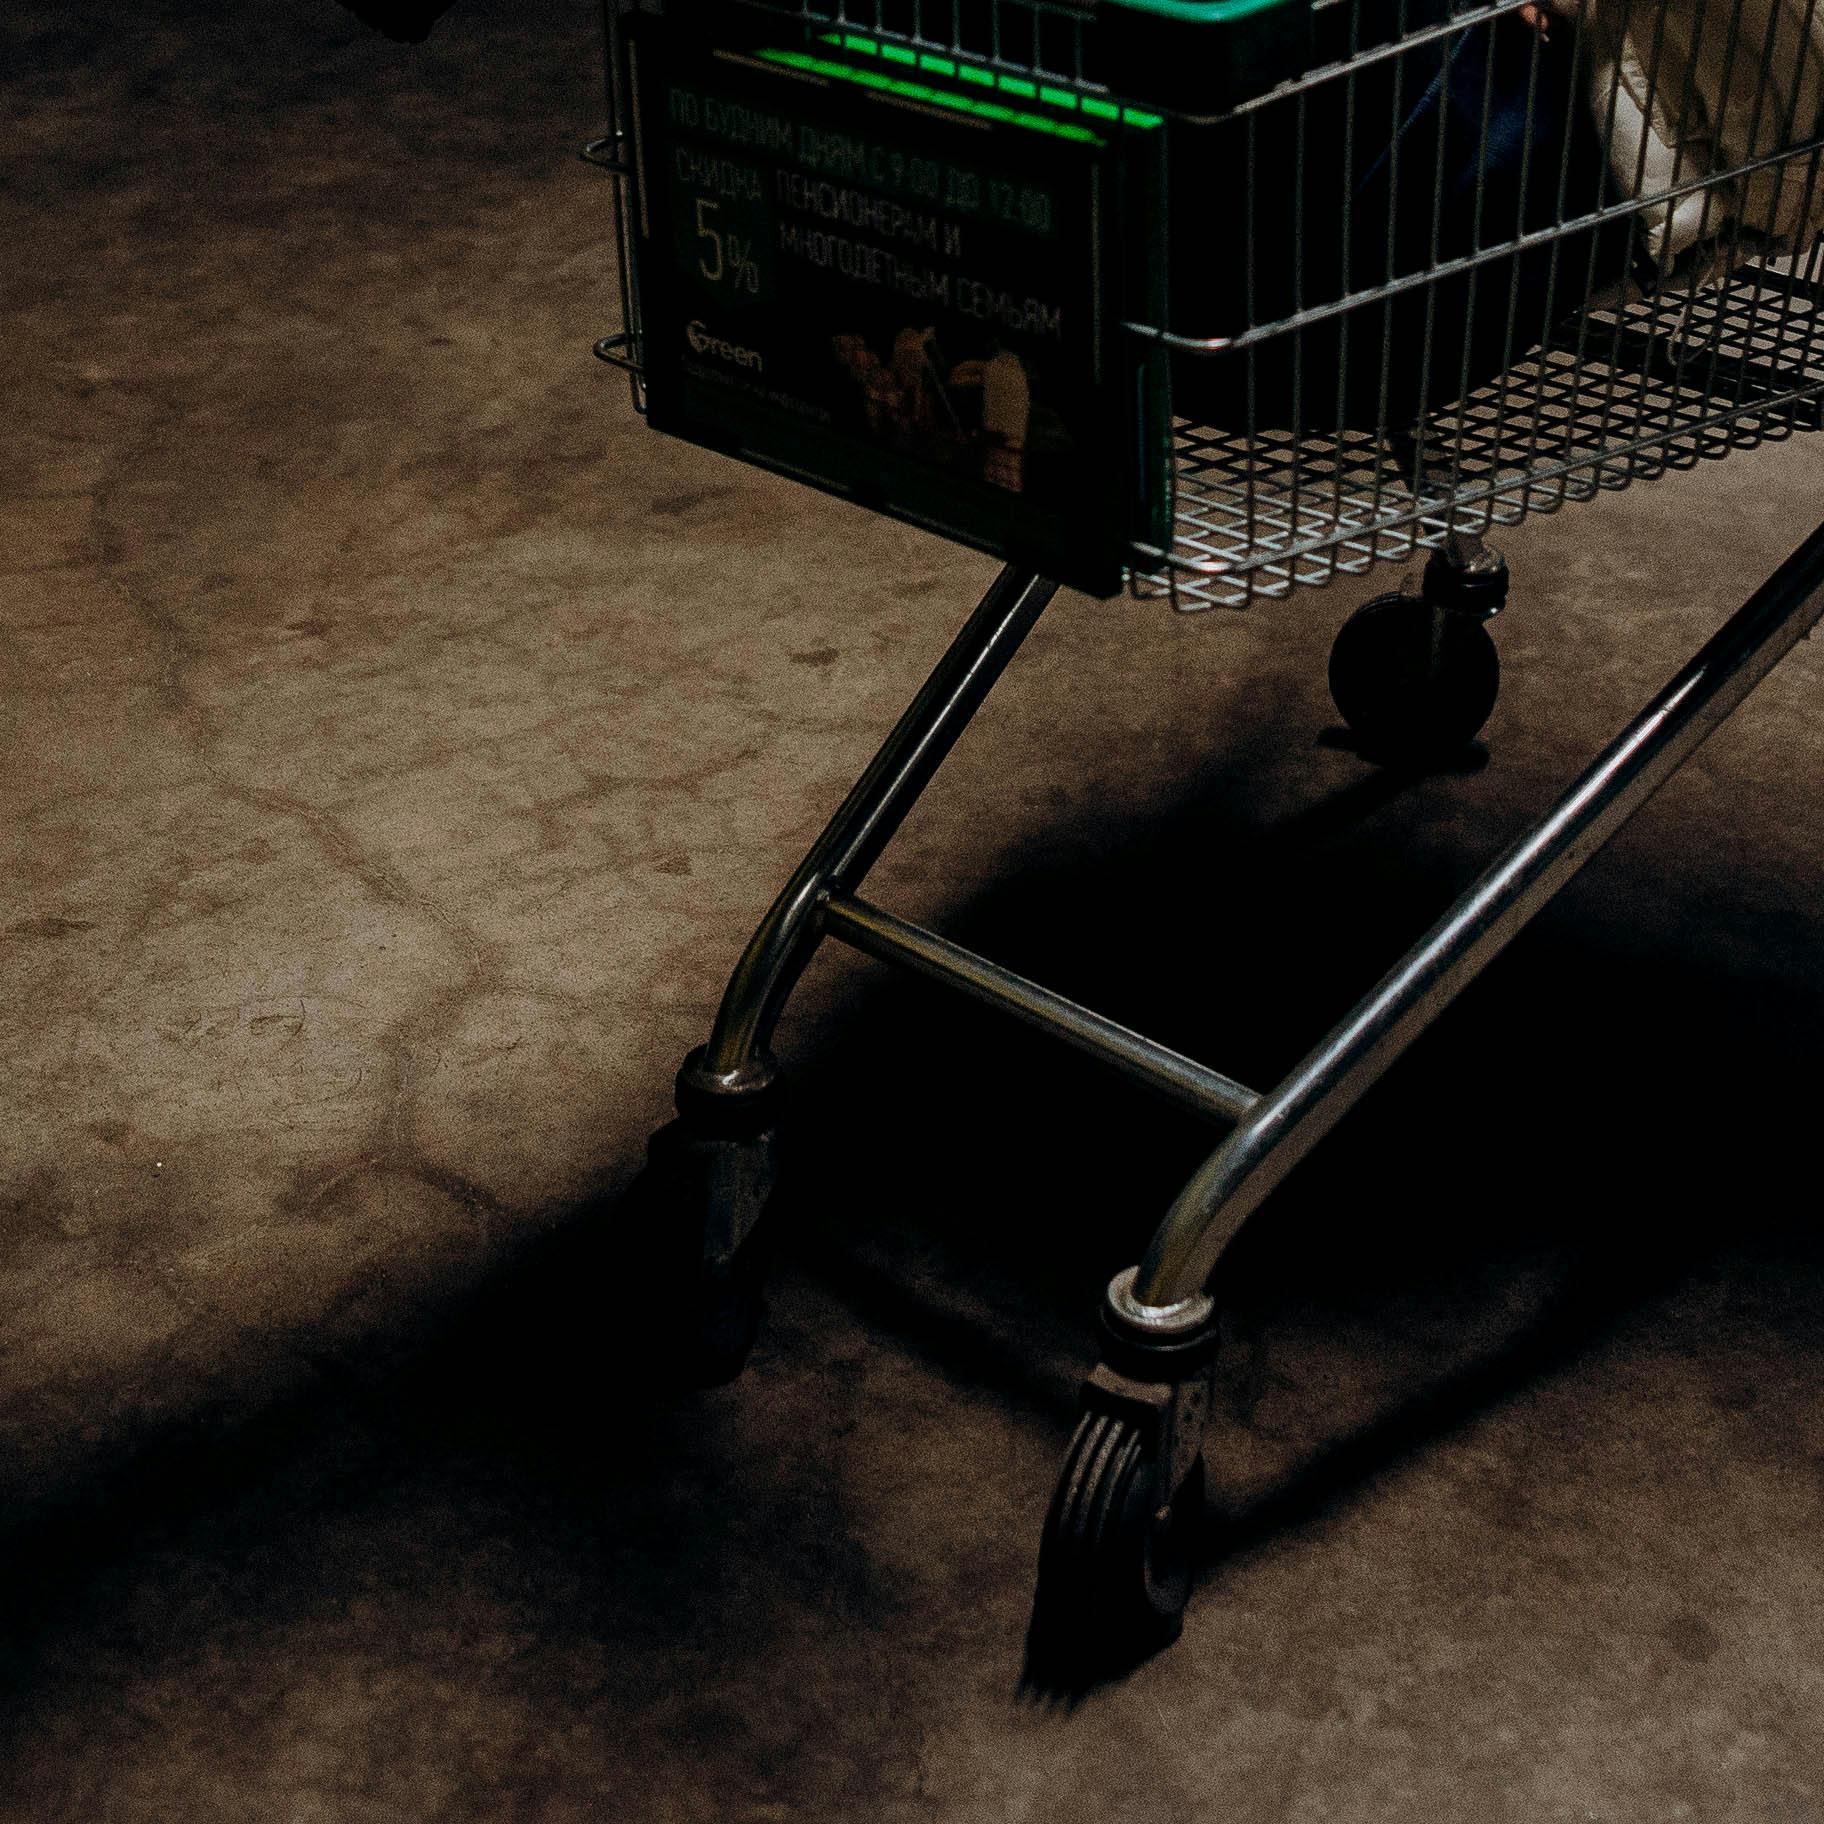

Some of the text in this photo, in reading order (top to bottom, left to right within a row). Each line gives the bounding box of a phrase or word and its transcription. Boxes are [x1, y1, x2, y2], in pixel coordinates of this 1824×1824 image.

[669, 87, 699, 127] ПО
[798, 124, 866, 179] ДНЯМ
[675, 146, 763, 201] СКИДКА
[694, 196, 761, 295] 5%
[775, 168, 962, 259] ПЕНСИОНЕРАМ И
[778, 220, 1063, 342] МНОГОДЕТНЫМ СЕМЬЯМ
[684, 318, 765, 374] Green
